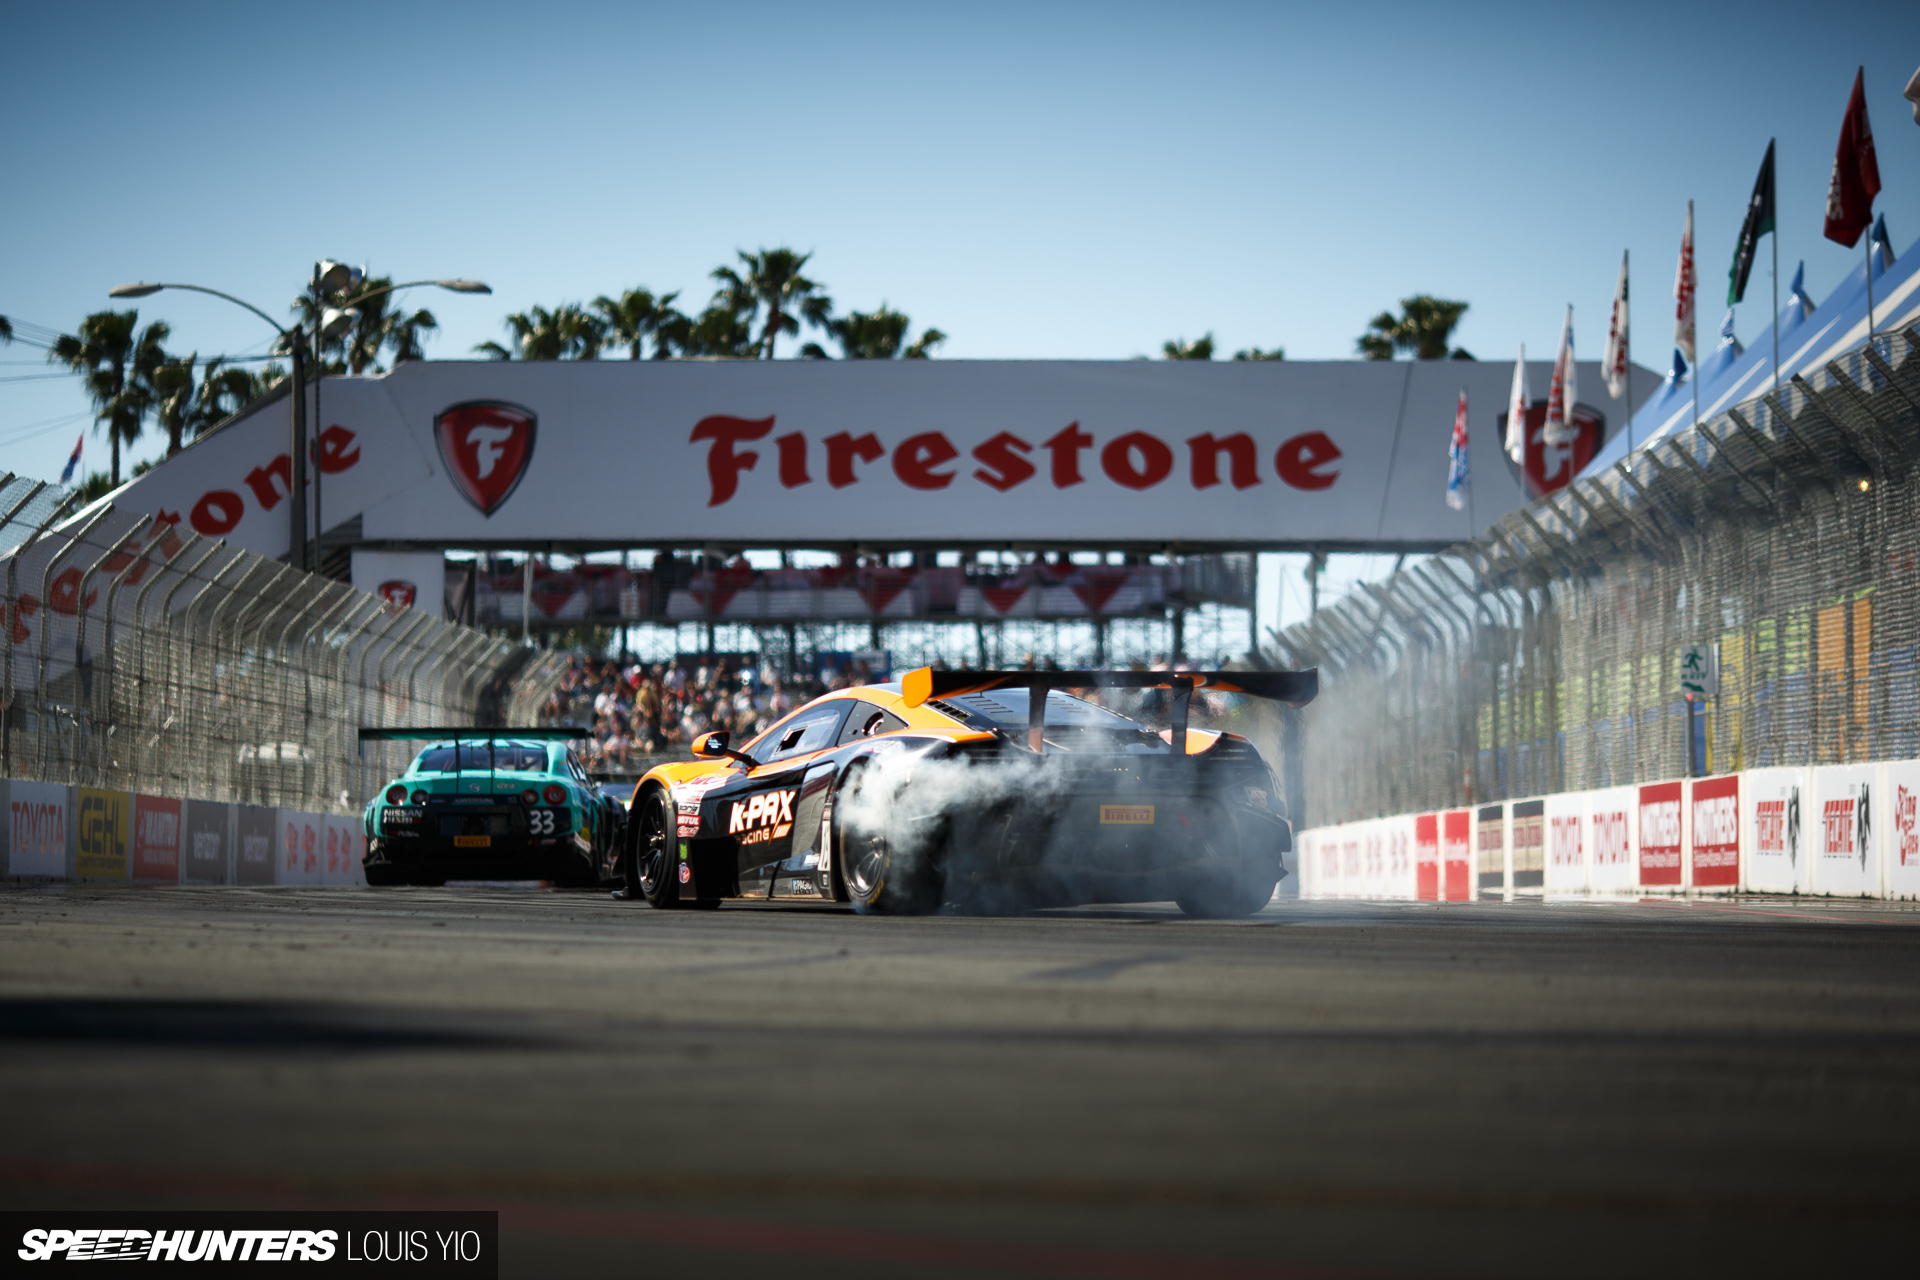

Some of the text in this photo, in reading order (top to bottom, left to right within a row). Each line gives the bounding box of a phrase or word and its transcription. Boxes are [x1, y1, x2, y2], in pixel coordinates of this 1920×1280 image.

[689, 412, 1344, 508] Firestone
[11, 801, 65, 855] TOYOTA
[80, 796, 125, 856] GEHL
[383, 809, 422, 818] NISSAN
[530, 810, 555, 835] 33
[677, 816, 699, 825] MOTUL
[729, 788, 797, 834] K-PAX
[1104, 808, 1150, 820] PIRELLI
[1551, 816, 1583, 865] TOYOTA
[1593, 811, 1630, 864] TOYOTA
